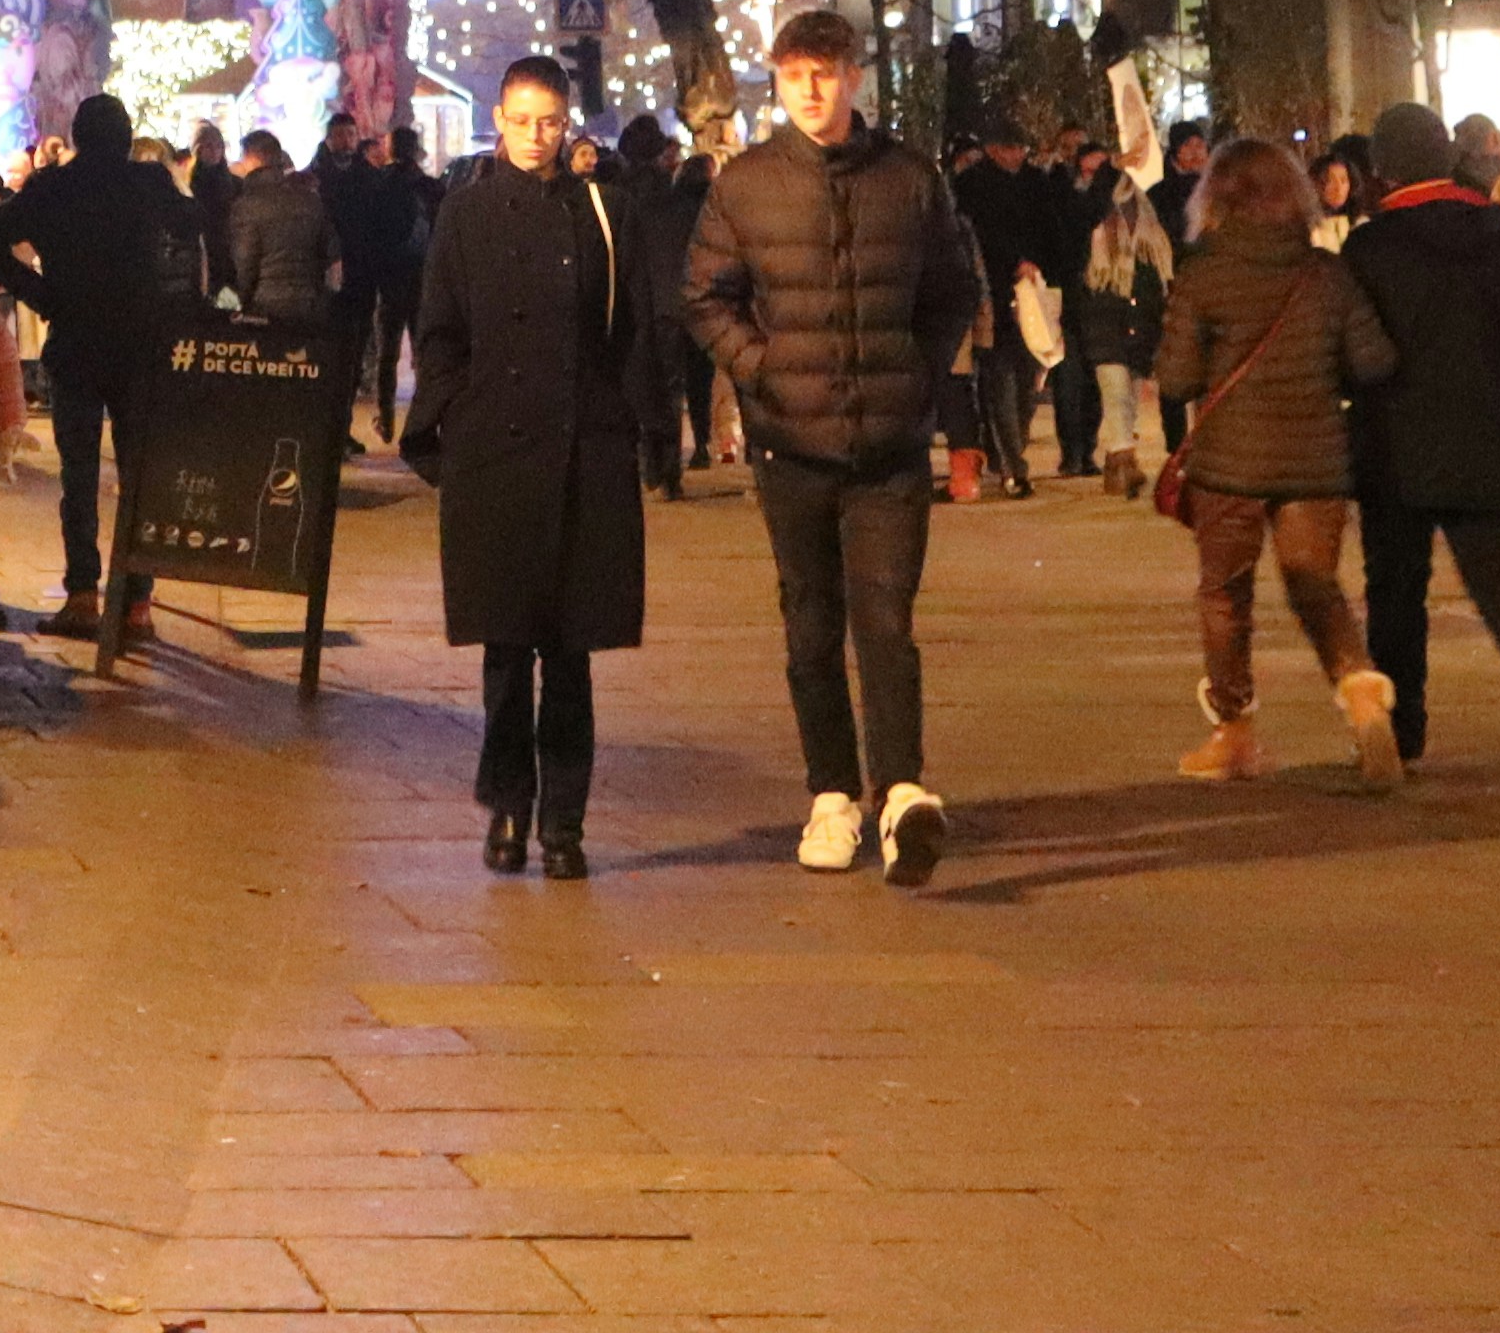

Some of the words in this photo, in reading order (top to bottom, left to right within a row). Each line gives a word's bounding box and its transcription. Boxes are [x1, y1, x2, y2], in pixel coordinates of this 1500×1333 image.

[203, 358, 227, 373] DE
[229, 359, 252, 375] CE
[256, 361, 293, 377] VREI
[297, 364, 320, 379] TU
